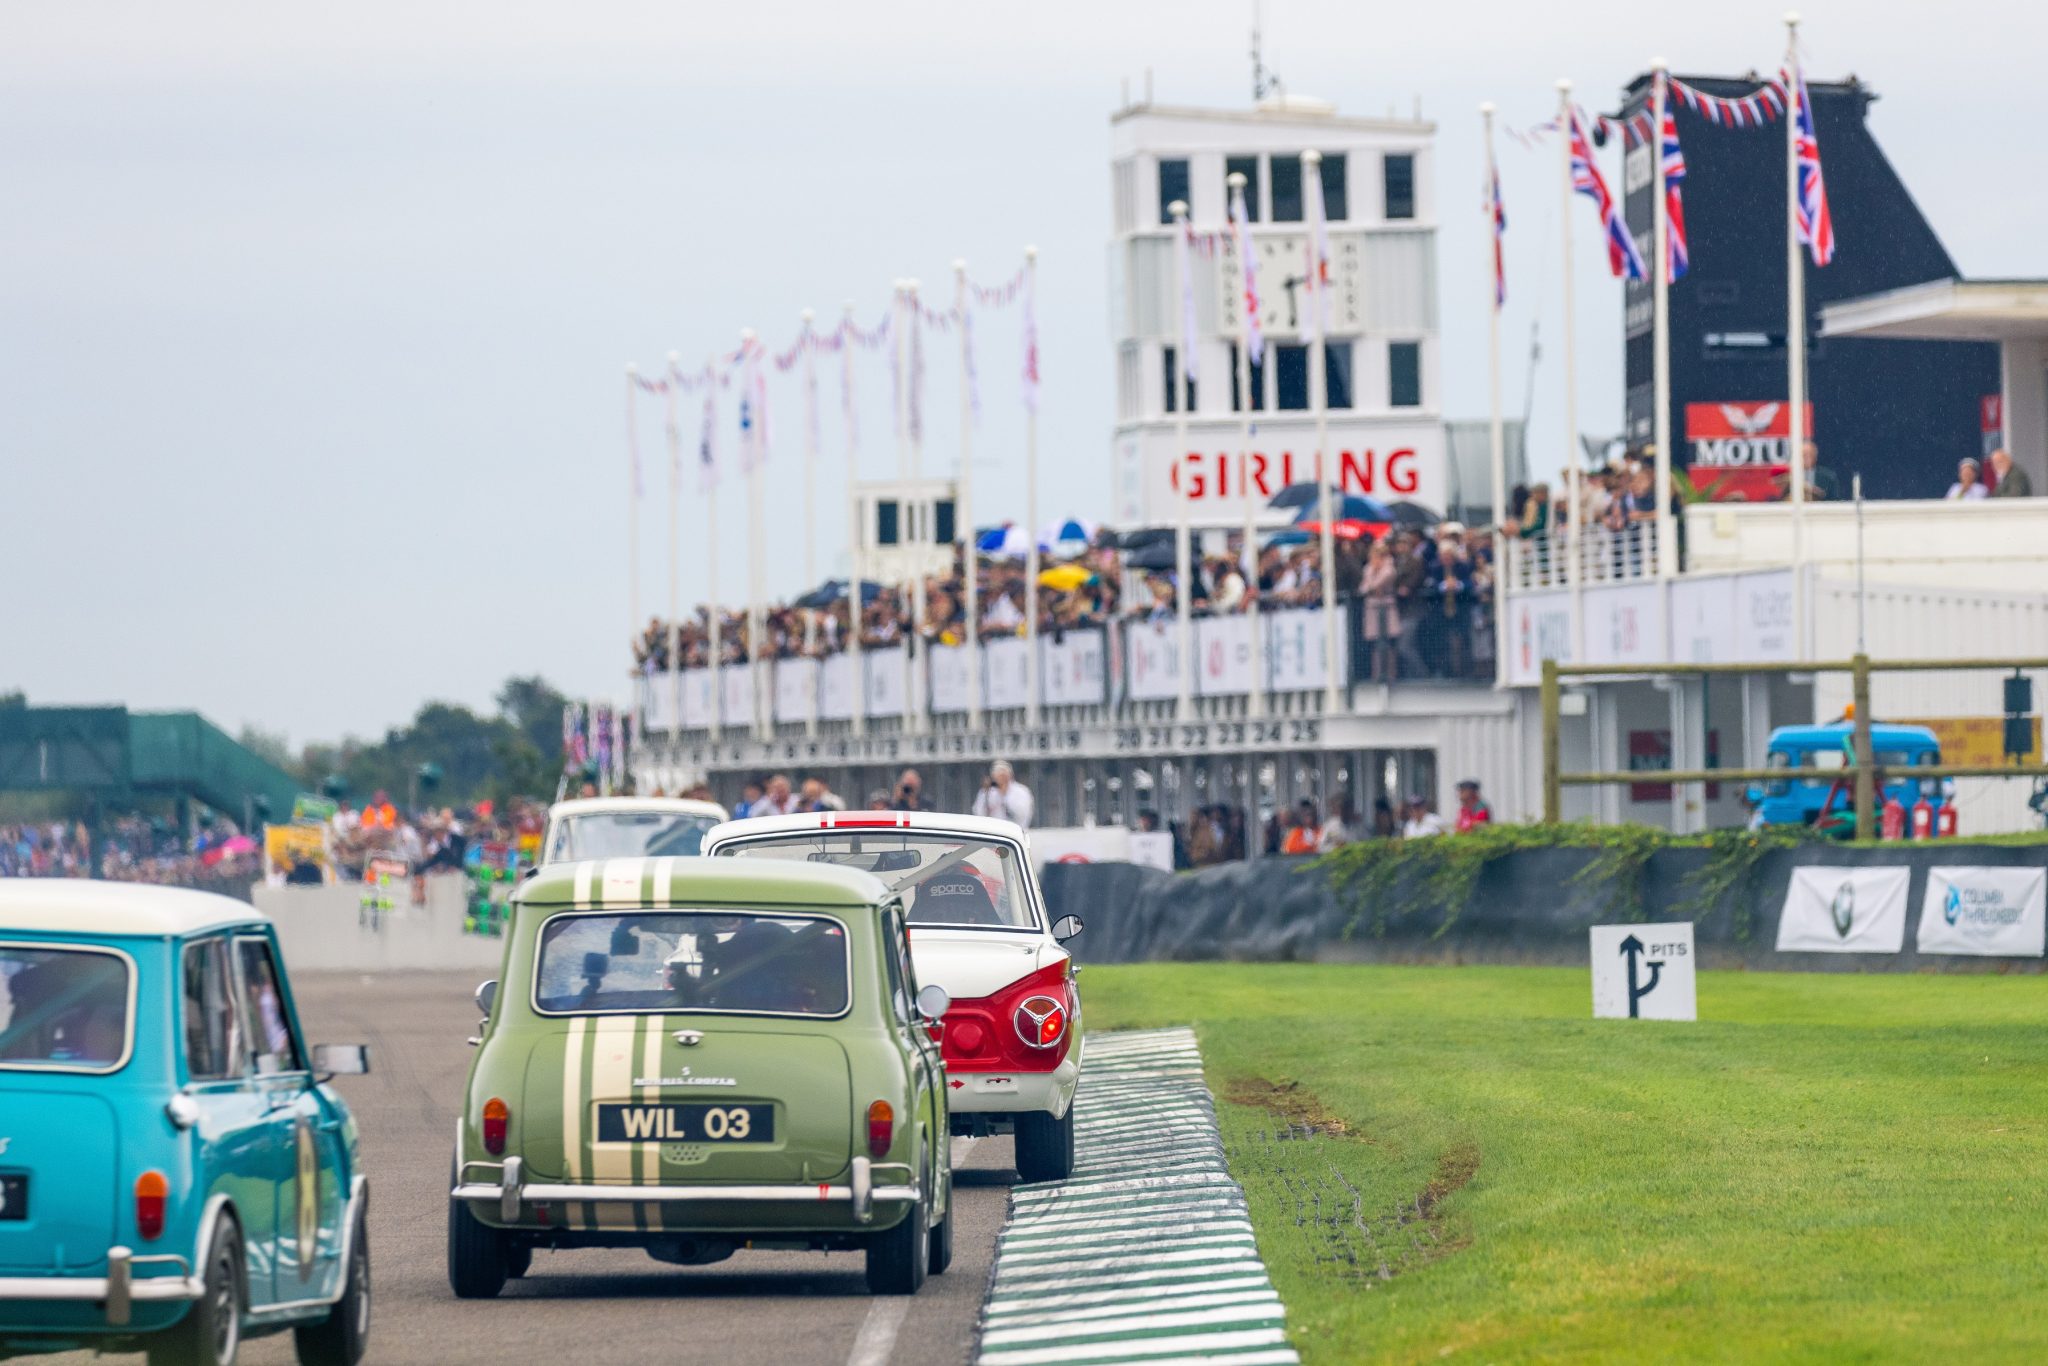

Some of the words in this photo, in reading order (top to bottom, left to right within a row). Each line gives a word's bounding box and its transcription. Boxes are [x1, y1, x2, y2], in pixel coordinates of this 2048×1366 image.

[1695, 438, 1791, 467] MOTU
[930, 882, 974, 895] sparco
[1651, 943, 1687, 956] PITS
[621, 1108, 685, 1139] WIL
[703, 1107, 751, 1140] 03
